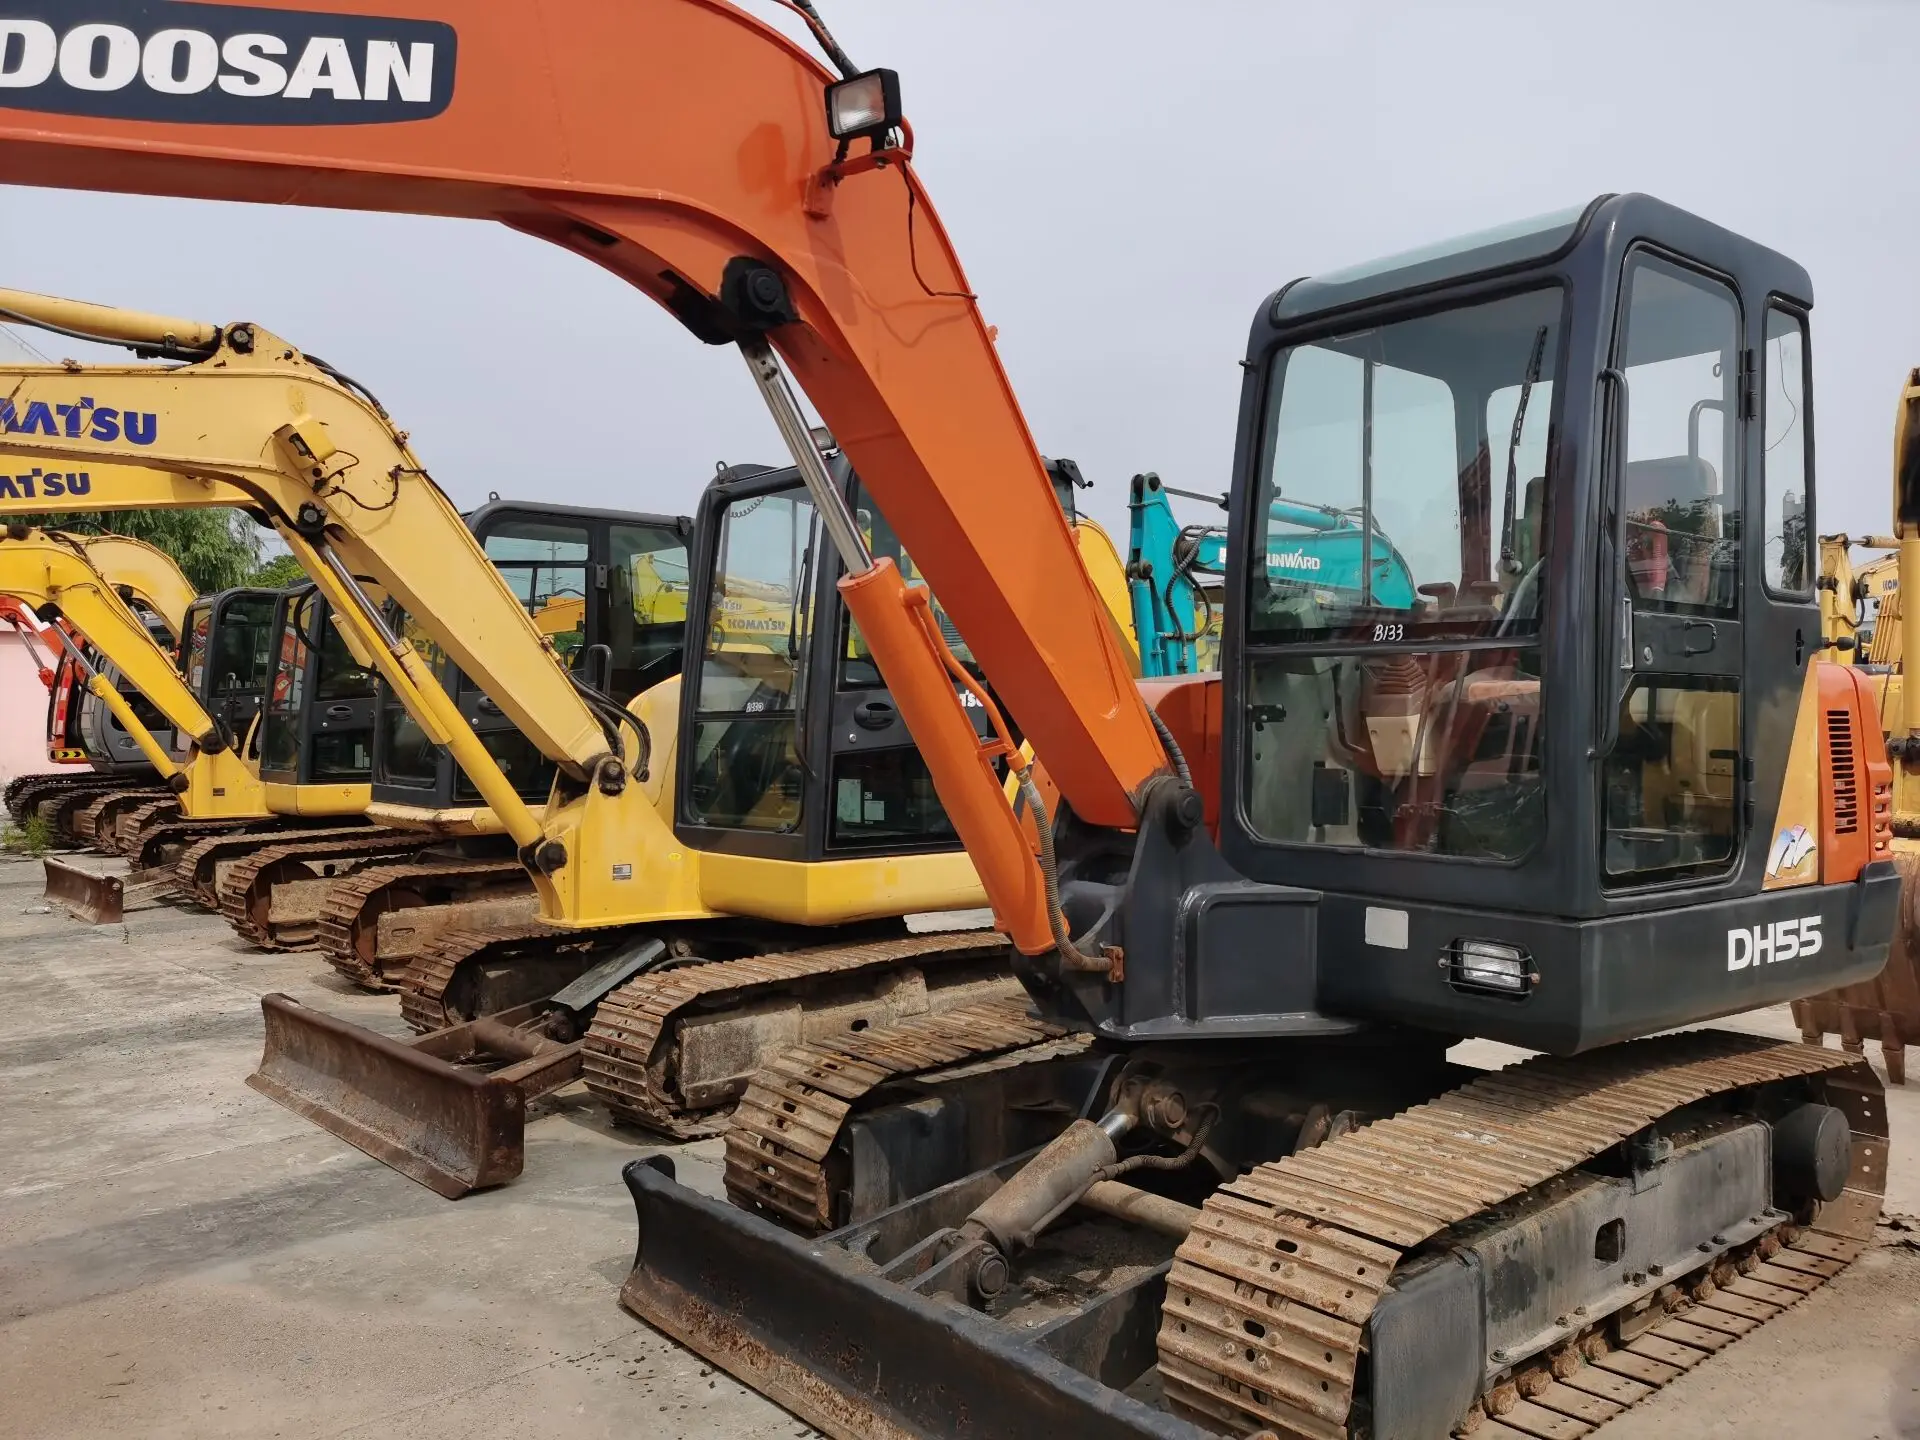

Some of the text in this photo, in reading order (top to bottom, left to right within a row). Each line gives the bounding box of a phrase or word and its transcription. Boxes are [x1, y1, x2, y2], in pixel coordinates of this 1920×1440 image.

[0, 19, 434, 103] DOOSAN
[728, 618, 785, 631] KOMATSU
[1373, 624, 1403, 641] B133
[1727, 915, 1823, 972] DH55
